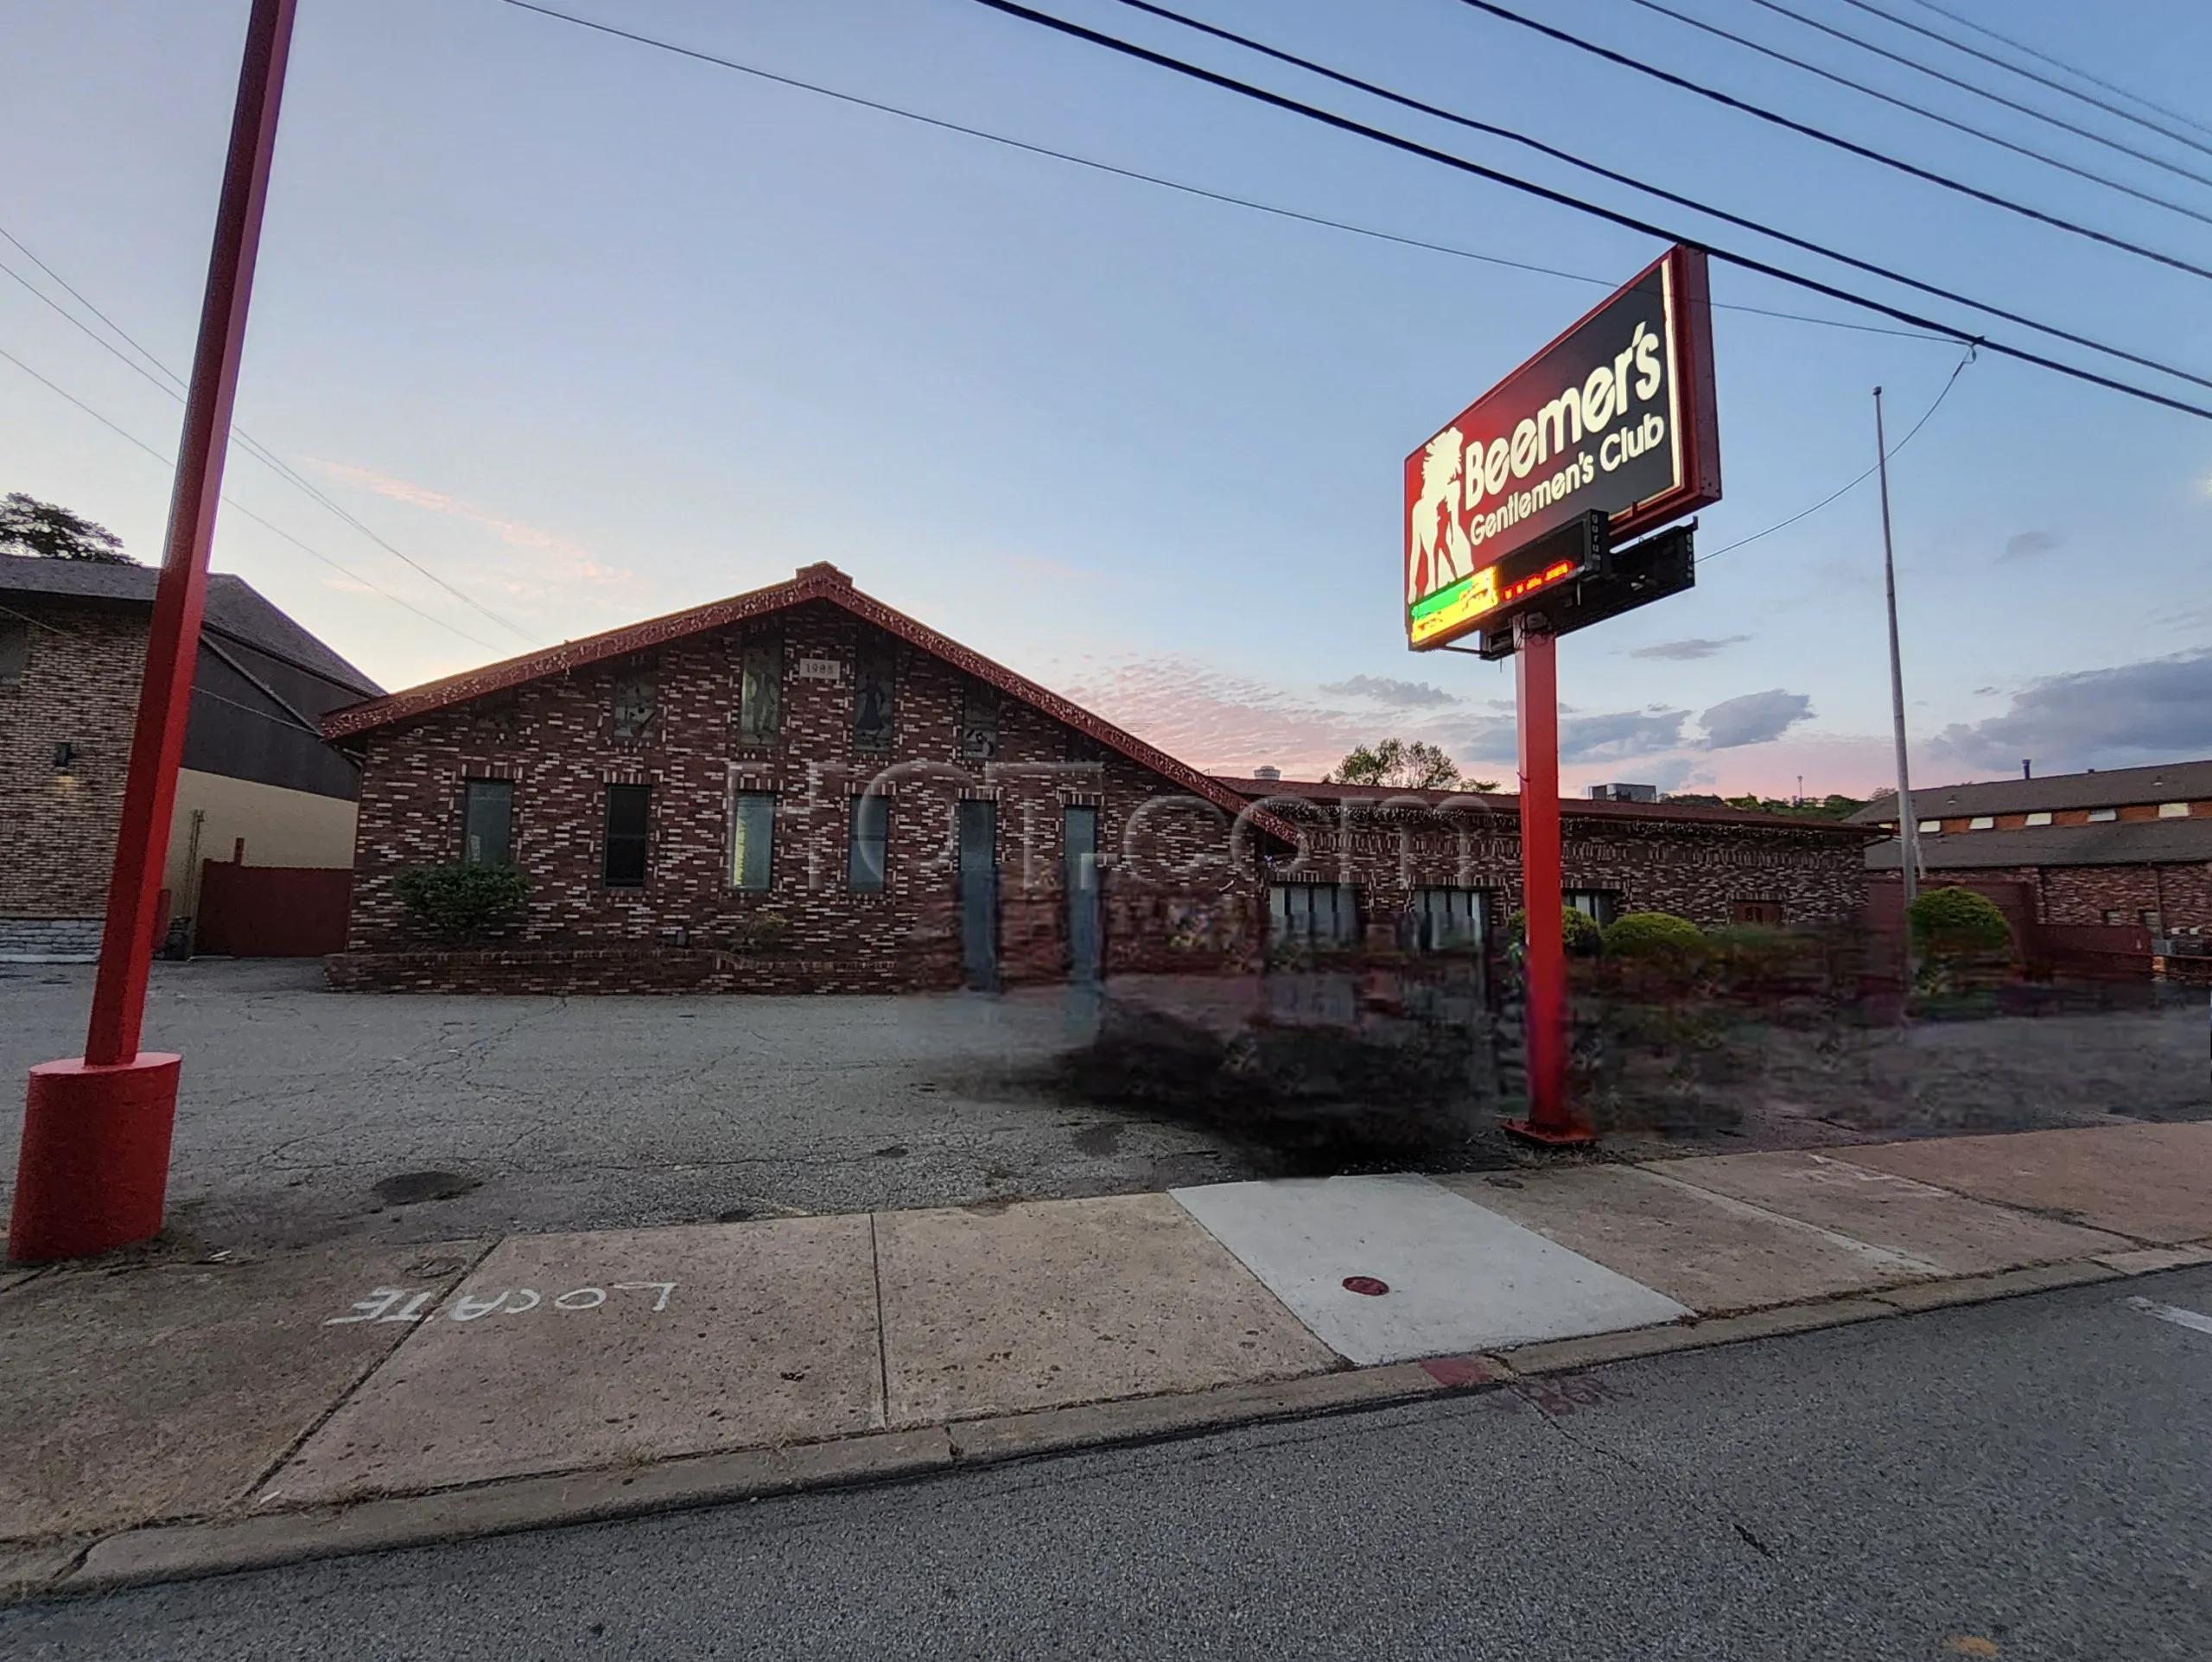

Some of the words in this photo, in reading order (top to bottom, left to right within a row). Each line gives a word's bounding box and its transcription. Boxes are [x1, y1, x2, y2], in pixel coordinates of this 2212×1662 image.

[1465, 321, 1662, 512] Beemer's
[1471, 452, 1594, 546] Gentlemen's
[1600, 413, 1664, 472] Club
[323, 1283, 678, 1326] LOCATE
